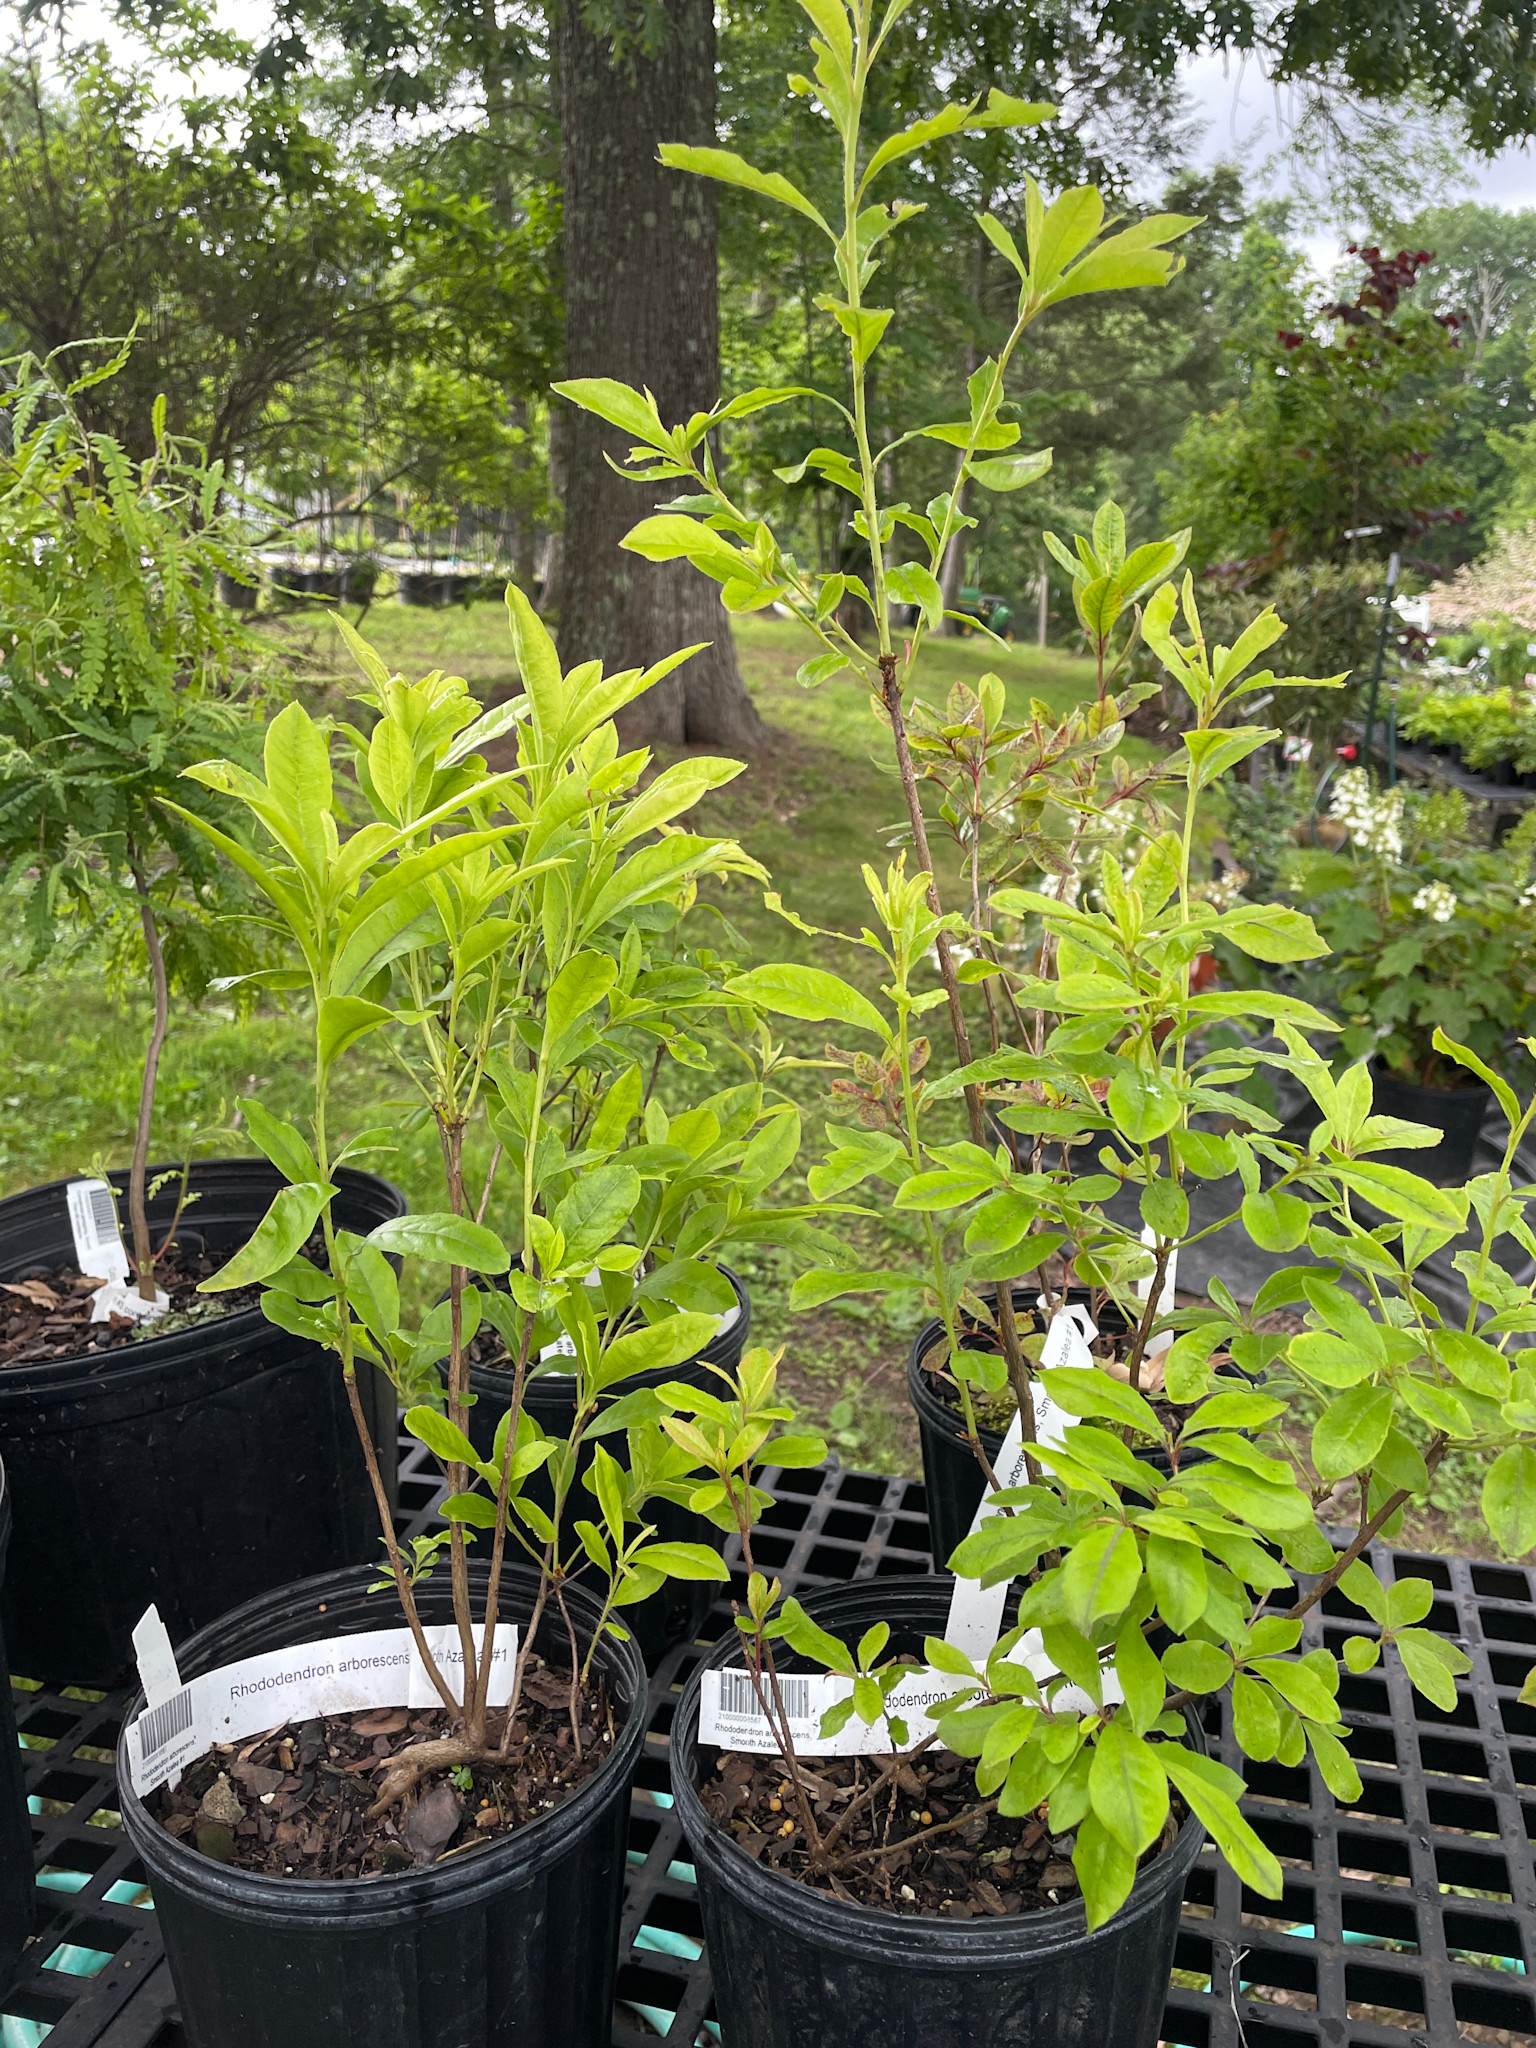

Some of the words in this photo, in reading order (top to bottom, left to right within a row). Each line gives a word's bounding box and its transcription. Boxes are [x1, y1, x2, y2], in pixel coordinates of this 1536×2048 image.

[230, 1664, 334, 1700] Rhododendron
[339, 1653, 410, 1673] arborescens
[446, 1648, 483, 1663] Azaa
[492, 1648, 507, 1662] #1
[885, 1691, 947, 1708] dodendron
[730, 1737, 756, 1747] Smooth
[758, 1740, 778, 1748] Azale
